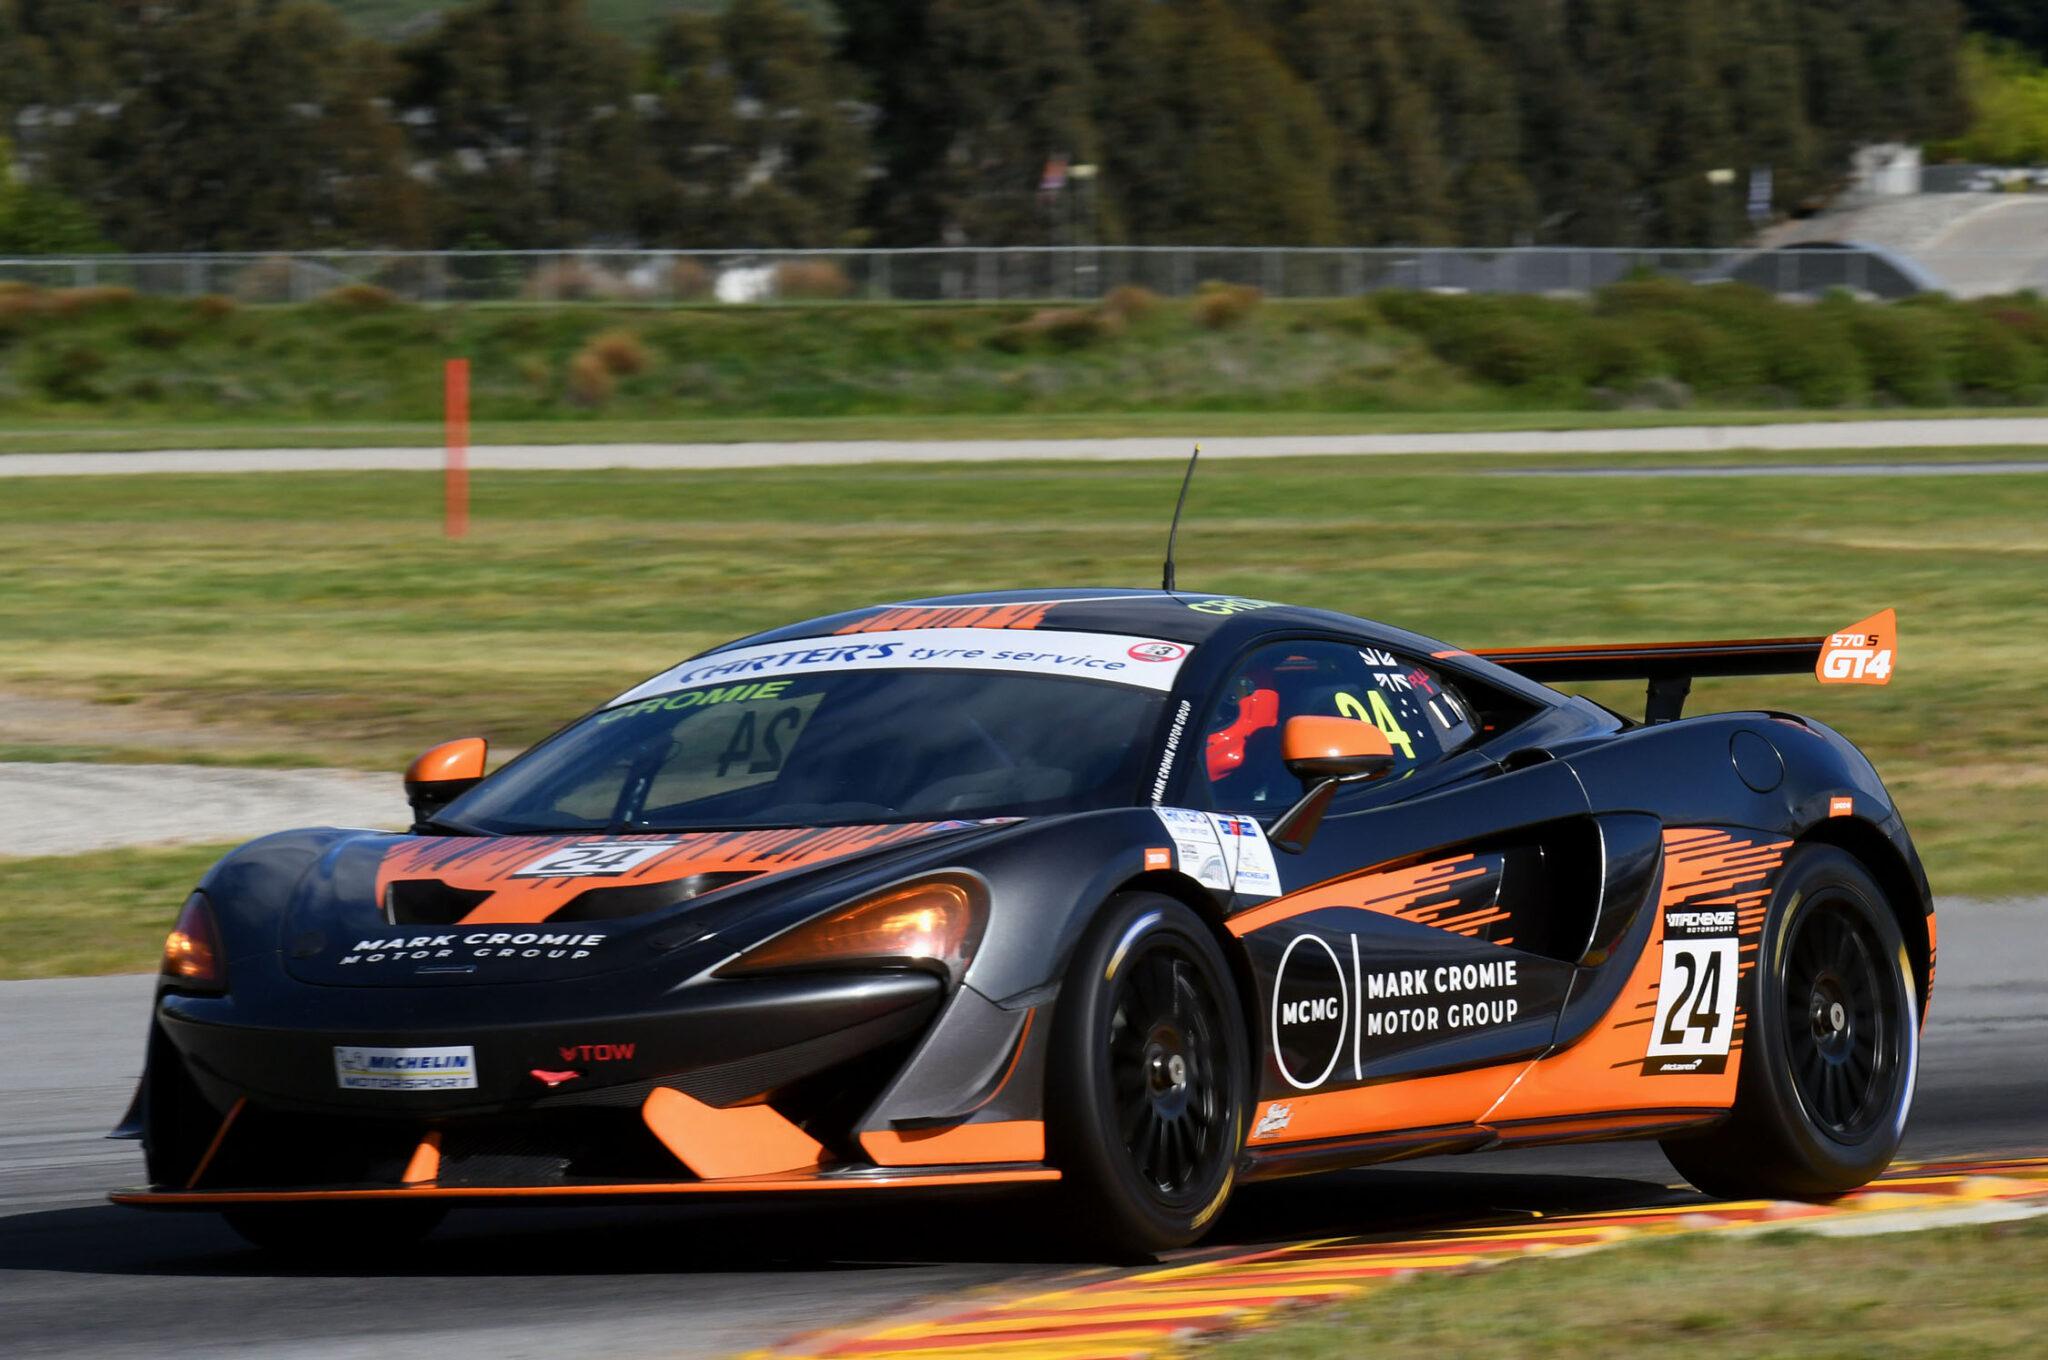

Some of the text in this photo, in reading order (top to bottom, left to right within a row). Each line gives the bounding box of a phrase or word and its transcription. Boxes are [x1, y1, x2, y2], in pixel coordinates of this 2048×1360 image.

[680, 642, 1127, 684] CARTER'S tyre service
[1823, 649, 1892, 679] GT4
[597, 680, 795, 724] CROMIE
[1174, 699, 1192, 725] GROUP
[1166, 723, 1185, 751] MOTOR
[536, 848, 646, 872] 24
[337, 947, 592, 965] MOTOR GROUP
[351, 932, 607, 952] MARK CROMIE
[1367, 960, 1518, 1000] MARK CROMIE
[1282, 996, 1339, 1026] MCMG
[1660, 951, 1722, 1046] 24
[1367, 998, 1519, 1037] MOTOR GROUP
[369, 1055, 469, 1069] MICHELIN
[576, 1042, 637, 1062] TOW
